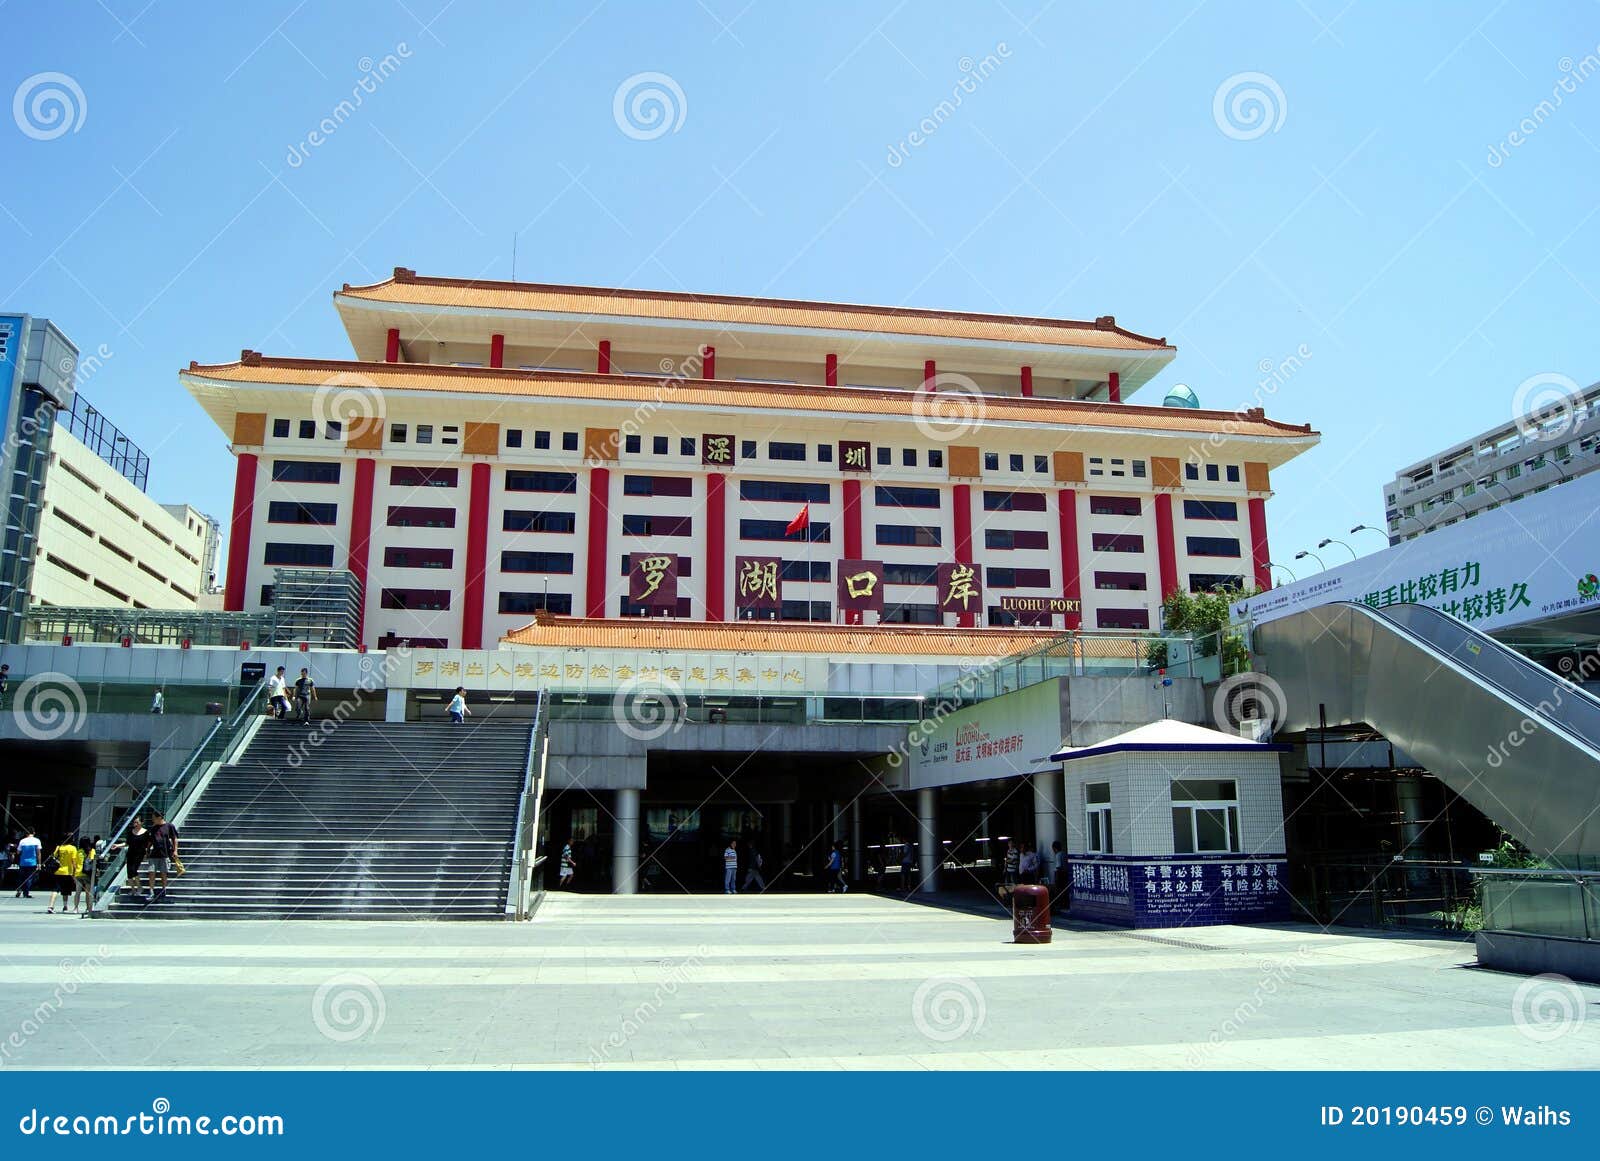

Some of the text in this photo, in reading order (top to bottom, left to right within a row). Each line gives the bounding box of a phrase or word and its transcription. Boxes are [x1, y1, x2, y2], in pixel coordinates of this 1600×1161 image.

[636, 556, 980, 611] 罗湖口岸
[1349, 561, 1480, 610] 握手比较有力
[1002, 598, 1081, 612] LUOHU PORT
[1431, 582, 1532, 623] 比较持久
[415, 660, 806, 684] 罗湖出入境边防检查站信息采集中心
[1144, 865, 1203, 879] 有警必接
[1221, 864, 1278, 878] 有难必帮
[1144, 880, 1204, 893] 有求必应
[1221, 878, 1279, 892] 有险必救
